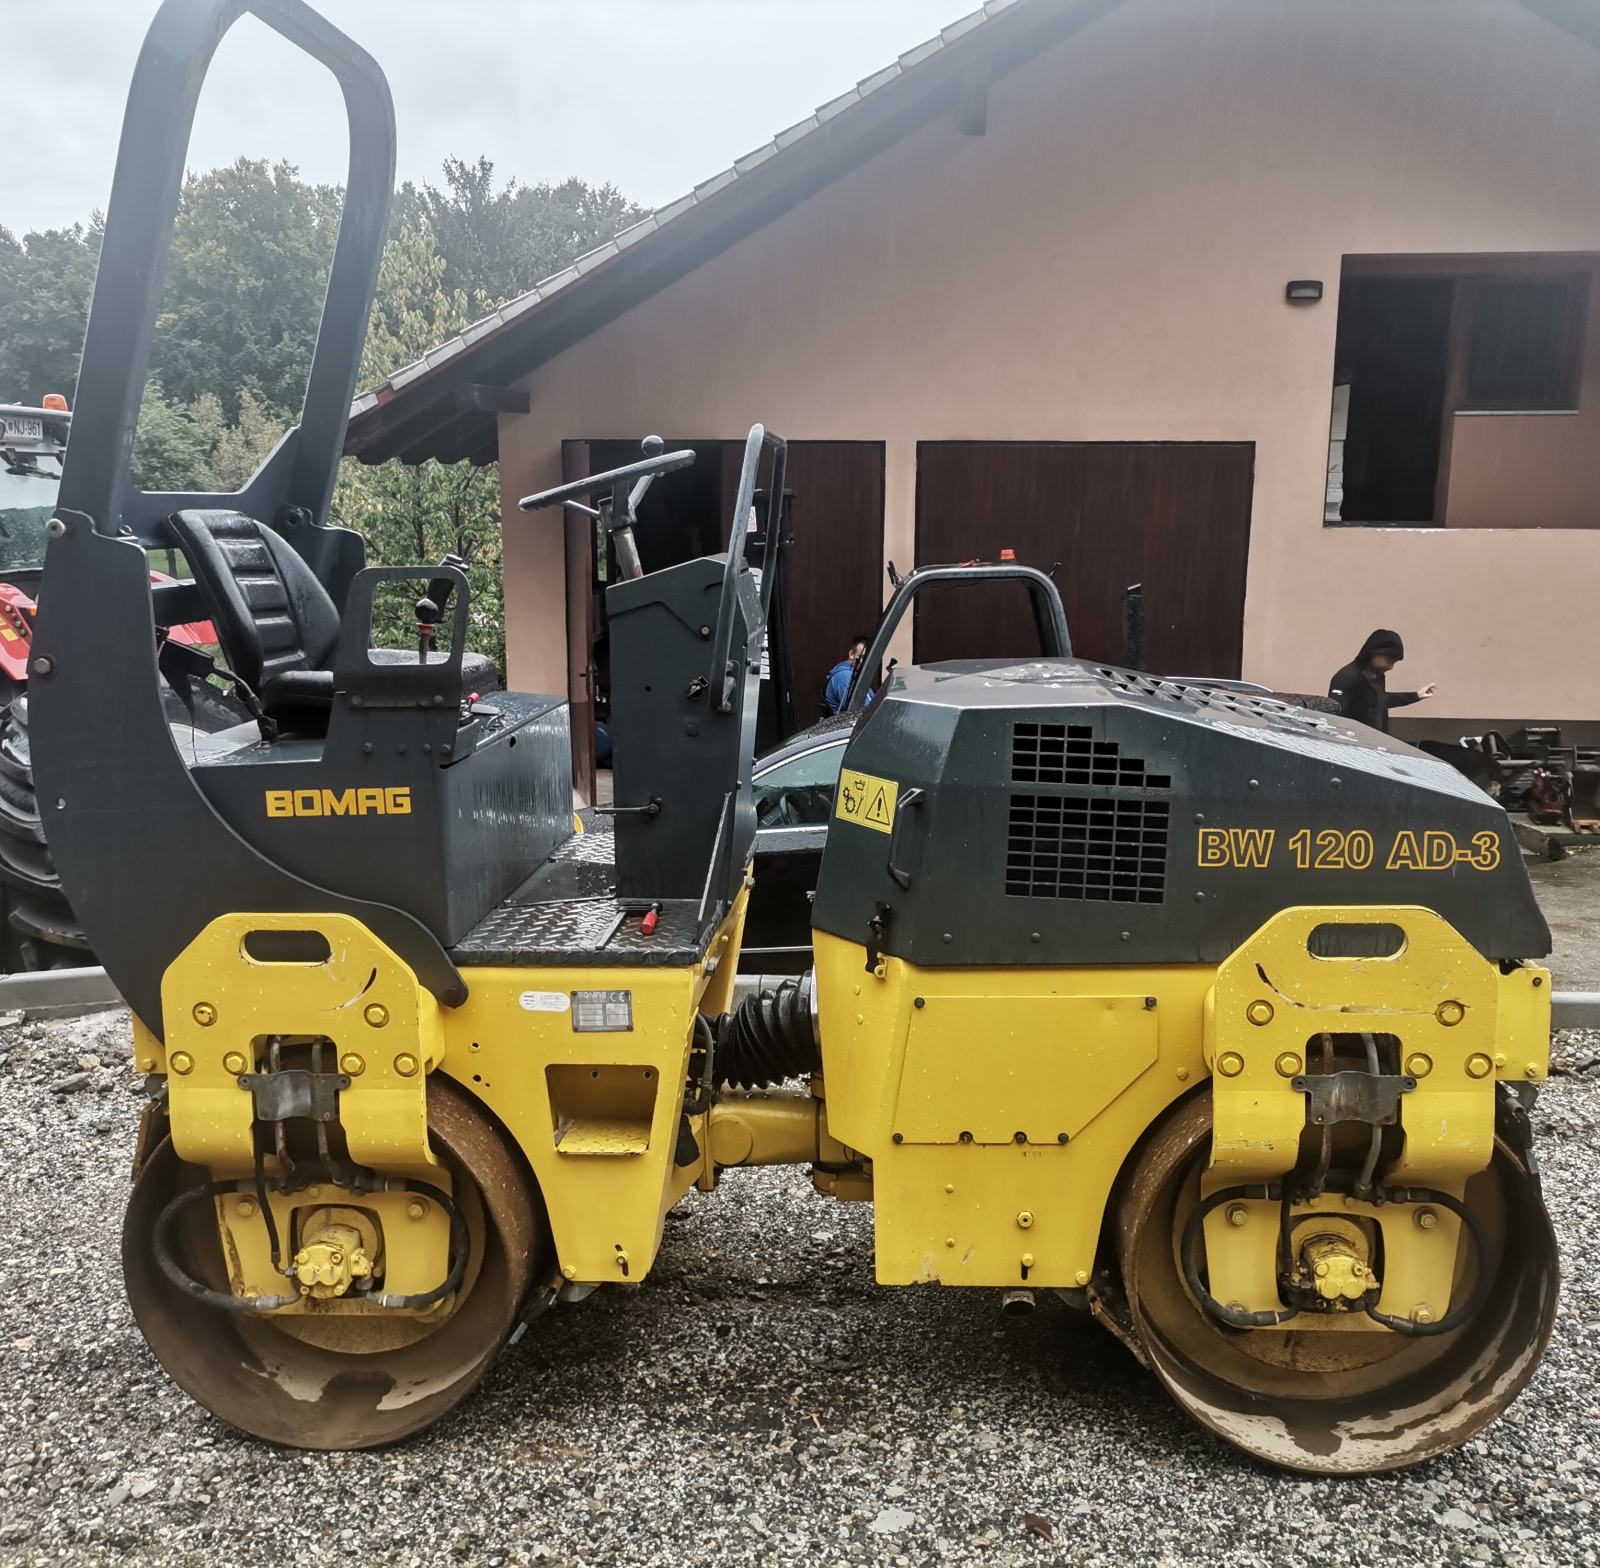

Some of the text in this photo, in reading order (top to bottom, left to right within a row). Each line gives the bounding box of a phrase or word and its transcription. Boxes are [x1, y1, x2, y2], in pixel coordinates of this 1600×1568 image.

[265, 787, 412, 817] BOMAG
[1197, 828, 1501, 871] BW 120 AD-3
